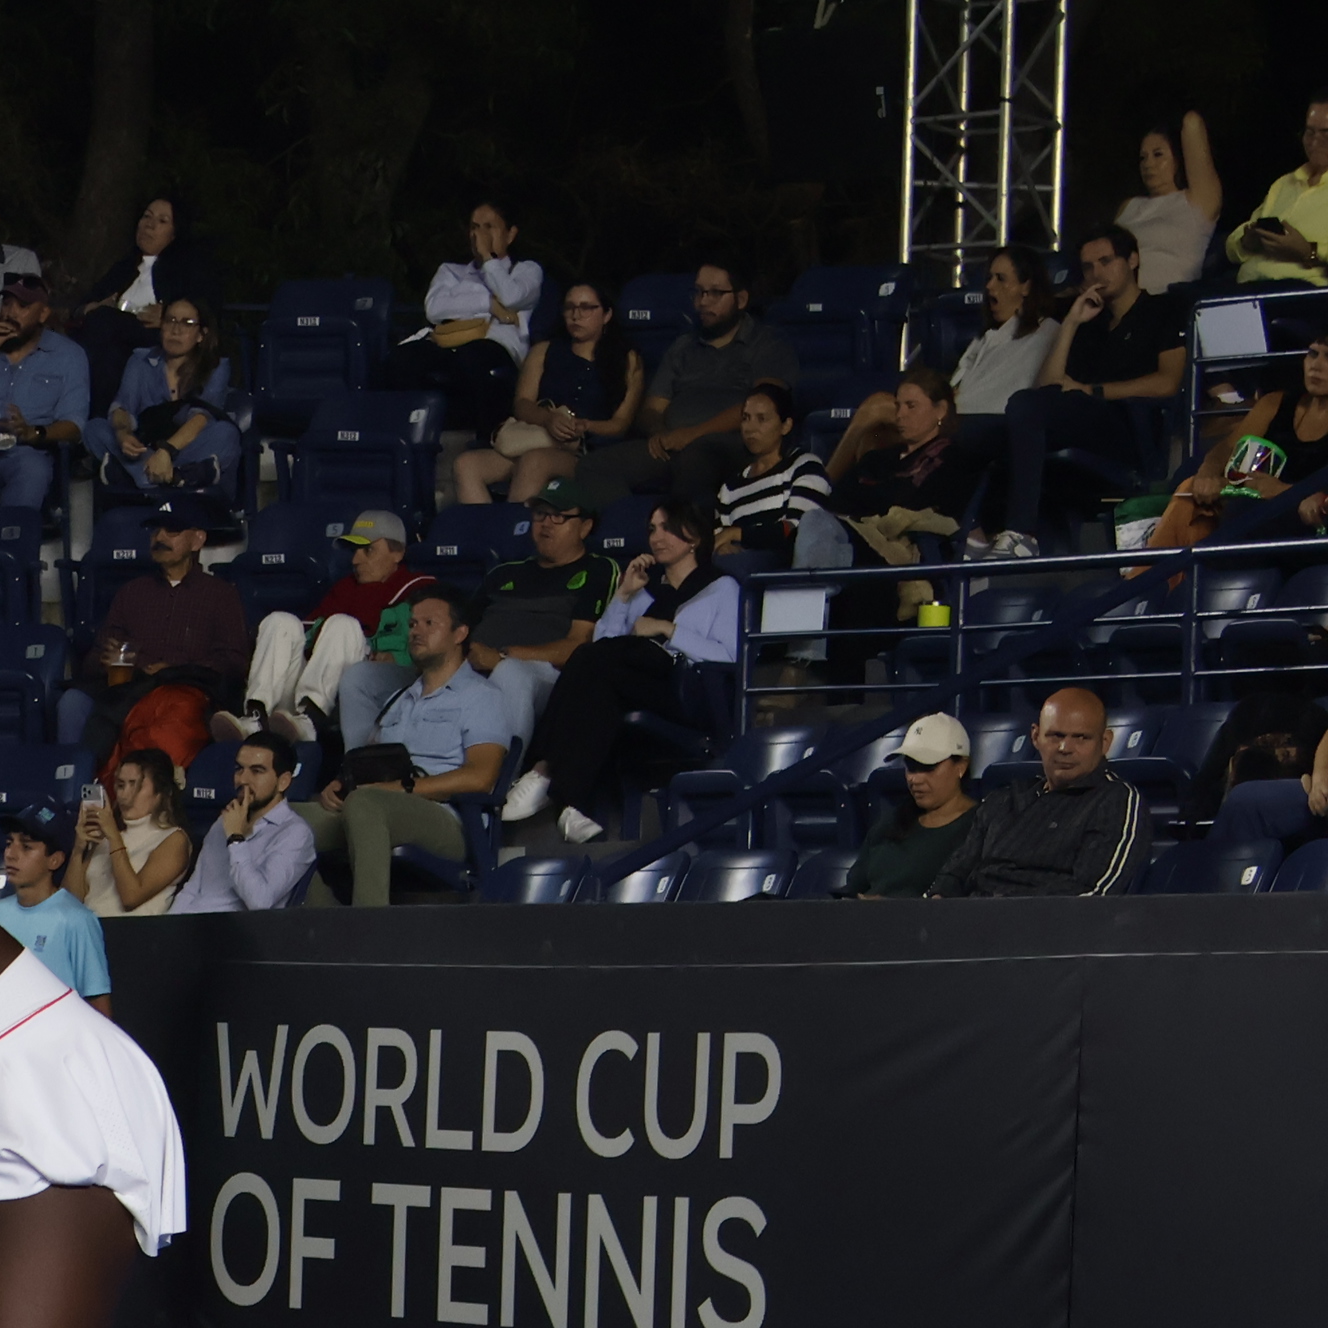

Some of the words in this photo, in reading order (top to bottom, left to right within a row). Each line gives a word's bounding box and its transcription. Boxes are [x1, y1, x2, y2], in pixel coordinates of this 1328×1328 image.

[216, 1021, 544, 1153] WORLD
[576, 1030, 782, 1160] CUP
[210, 1171, 341, 1310] OF
